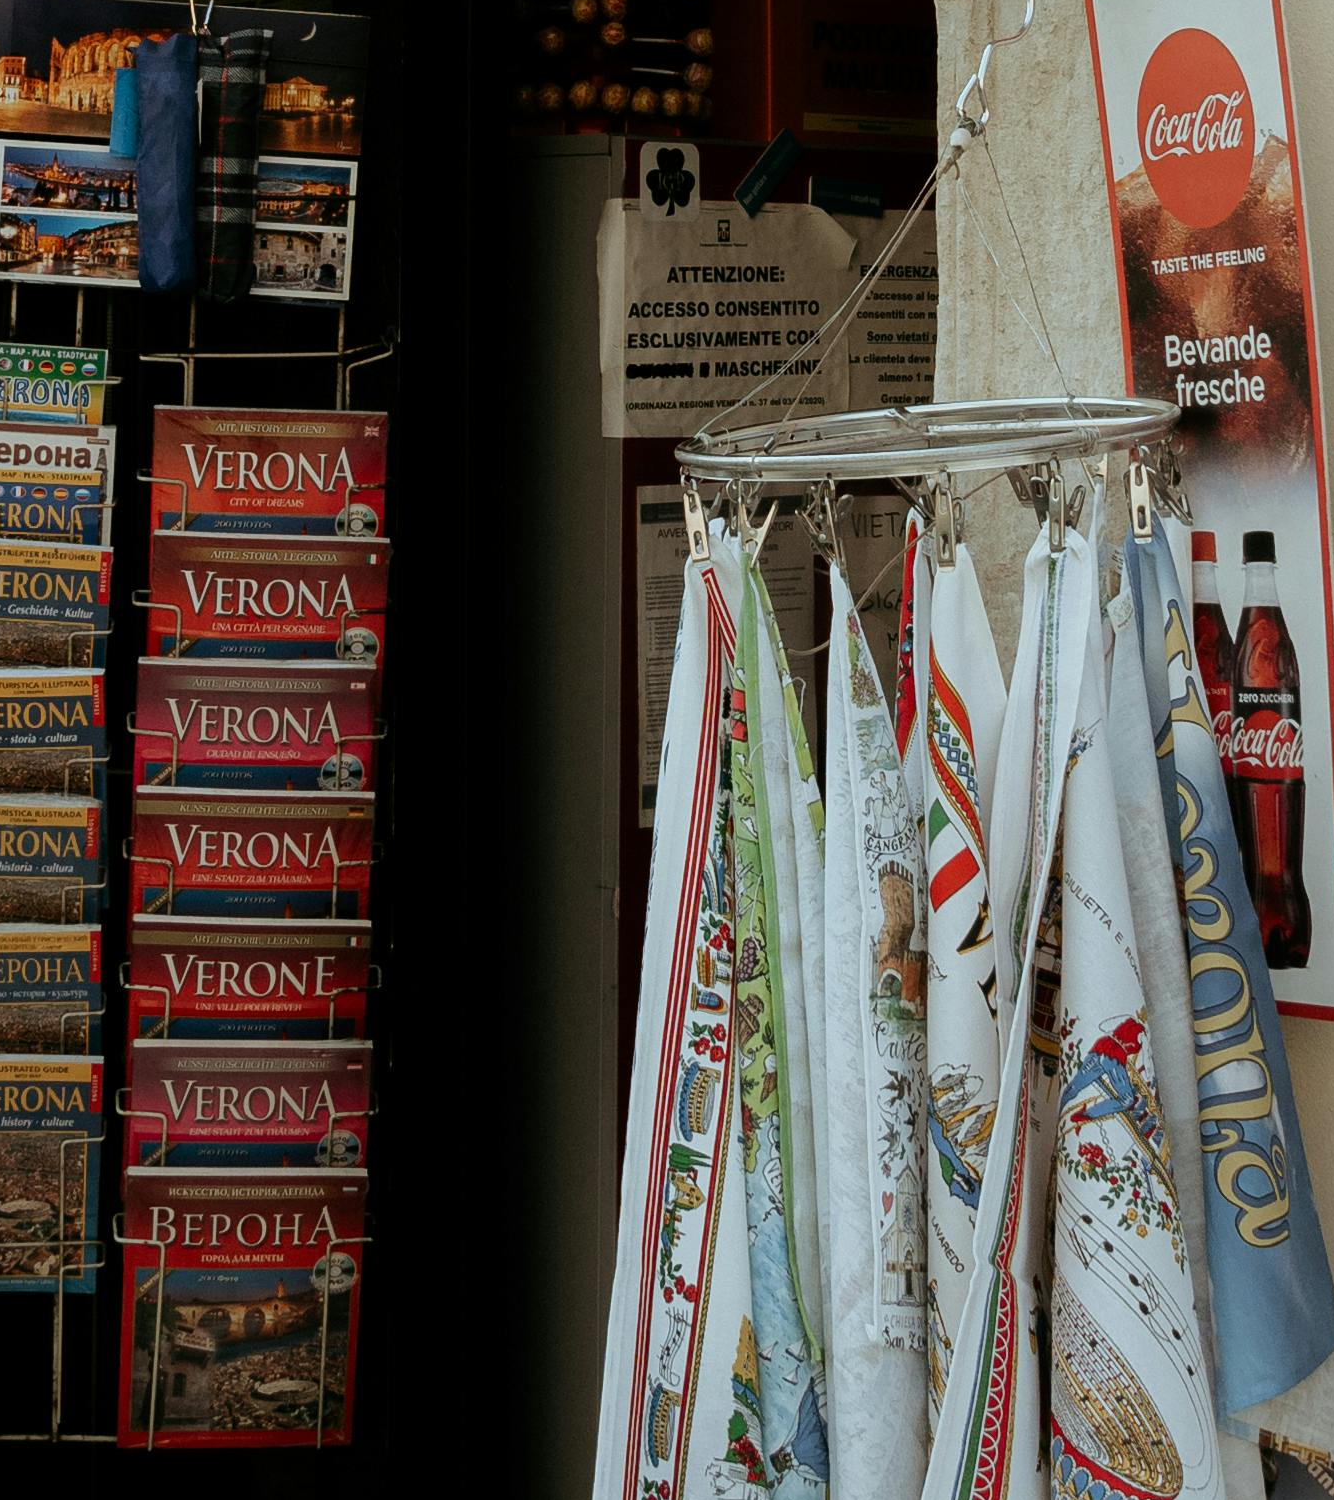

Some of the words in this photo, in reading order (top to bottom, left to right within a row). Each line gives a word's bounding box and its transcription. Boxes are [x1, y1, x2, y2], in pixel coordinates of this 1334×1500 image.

[1145, 90, 1246, 161] Coca-Cola
[1152, 256, 1188, 275] TASTE
[1191, 254, 1213, 270] THE
[1216, 247, 1265, 266] FEELING
[667, 267, 785, 283] ATTENZIONE:
[629, 302, 709, 318] ACCESSO
[715, 301, 819, 316] CONSENTITO
[857, 310, 905, 319] consentiti
[628, 331, 780, 348] ESCLUSIVAMENTE
[787, 330, 820, 345] CON
[867, 331, 893, 342] Sono
[897, 332, 929, 341] vietati
[10, 347, 25, 355] MAP
[31, 349, 50, 358] PLAN
[57, 351, 98, 360] STADTPLAN
[1165, 325, 1271, 368] Bevande
[850, 354, 860, 363] La
[864, 354, 905, 363] clientela
[908, 355, 930, 363] deve
[715, 360, 821, 377] MASCHERINE
[879, 373, 913, 382] almeno
[1175, 368, 1265, 407] fresche
[881, 394, 911, 403] Grazie
[915, 396, 932, 404] per
[286, 425, 326, 434] LEGEND
[180, 443, 360, 493] VERONA
[229, 498, 249, 507] CITY
[252, 499, 265, 507] OF
[267, 499, 304, 508] DREAMS
[283, 553, 338, 563] LEGGENDA
[180, 570, 360, 618] VERONA
[8, 604, 58, 616] Geschichte
[65, 608, 93, 619] Kultur
[212, 623, 231, 632] UNA
[234, 622, 260, 632] CITTÀ
[262, 624, 281, 632] PER
[283, 624, 326, 633] SOGNARE
[1238, 693, 1258, 703] zero
[1260, 694, 1294, 704] ZUCCHERI
[165, 698, 340, 744] VERONA
[10, 733, 36, 744] storia
[45, 732, 77, 742] cultura
[35, 810, 81, 818] ILUSTRADA
[165, 823, 340, 869] VERONA
[42, 863, 73, 873] cultura
[1064, 871, 1113, 932] GIULIETTA
[1114, 934, 1123, 945] E
[161, 953, 336, 997] VERONE
[43, 1066, 69, 1074] GUIDE
[161, 1080, 337, 1121] VERONA
[1, 1116, 32, 1128] history
[41, 1117, 75, 1127] culture
[284, 1188, 325, 1196] ЛЕГЕНДА
[149, 1205, 337, 1247] ВЕРОНА
[931, 1215, 966, 1274] LAVAREDO
[201, 1254, 229, 1263] ГОРОД
[231, 1254, 250, 1263] ДЛЯ
[252, 1254, 284, 1262] МЕЧТЫ
